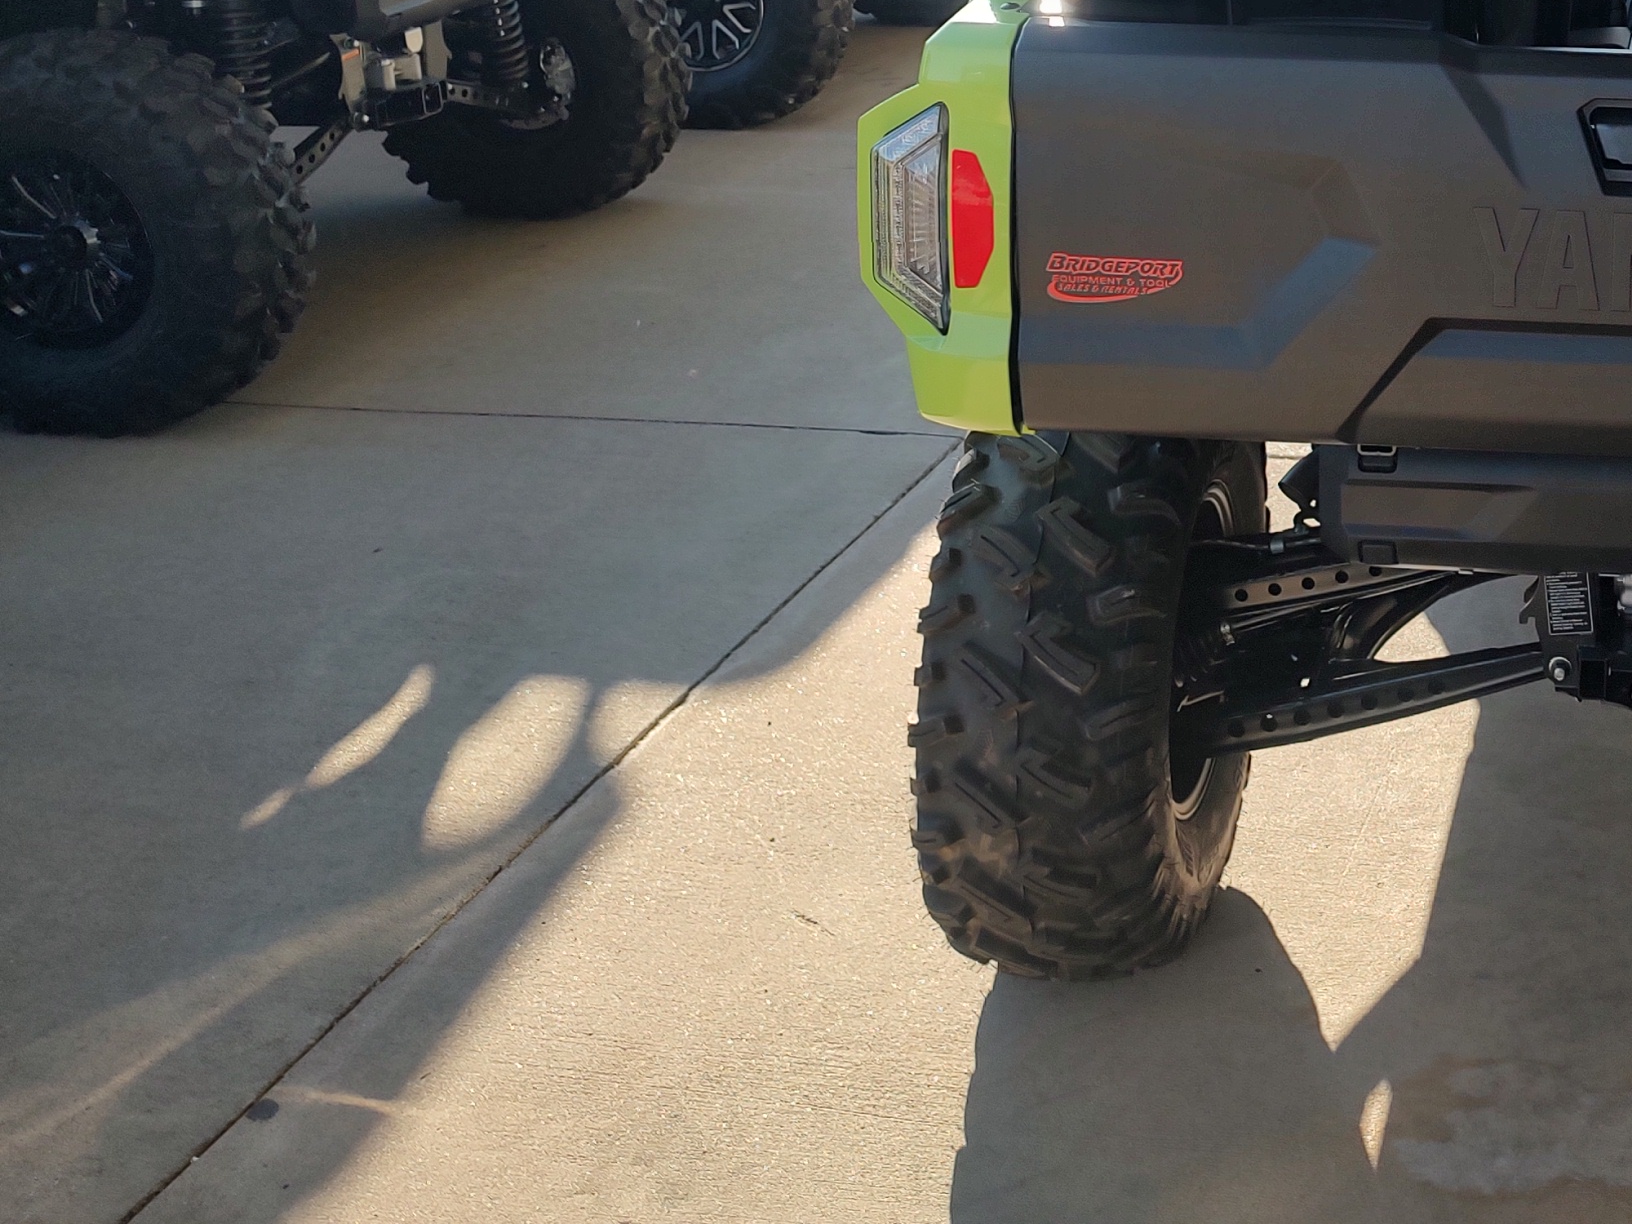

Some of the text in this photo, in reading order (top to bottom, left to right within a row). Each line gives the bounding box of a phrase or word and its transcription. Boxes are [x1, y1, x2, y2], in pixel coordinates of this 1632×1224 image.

[1049, 254, 1180, 276] BRIDGEPORT
[1052, 274, 1122, 286] EQUIPMENT
[1140, 278, 1170, 288] TOOL
[1058, 283, 1088, 292] SALES
